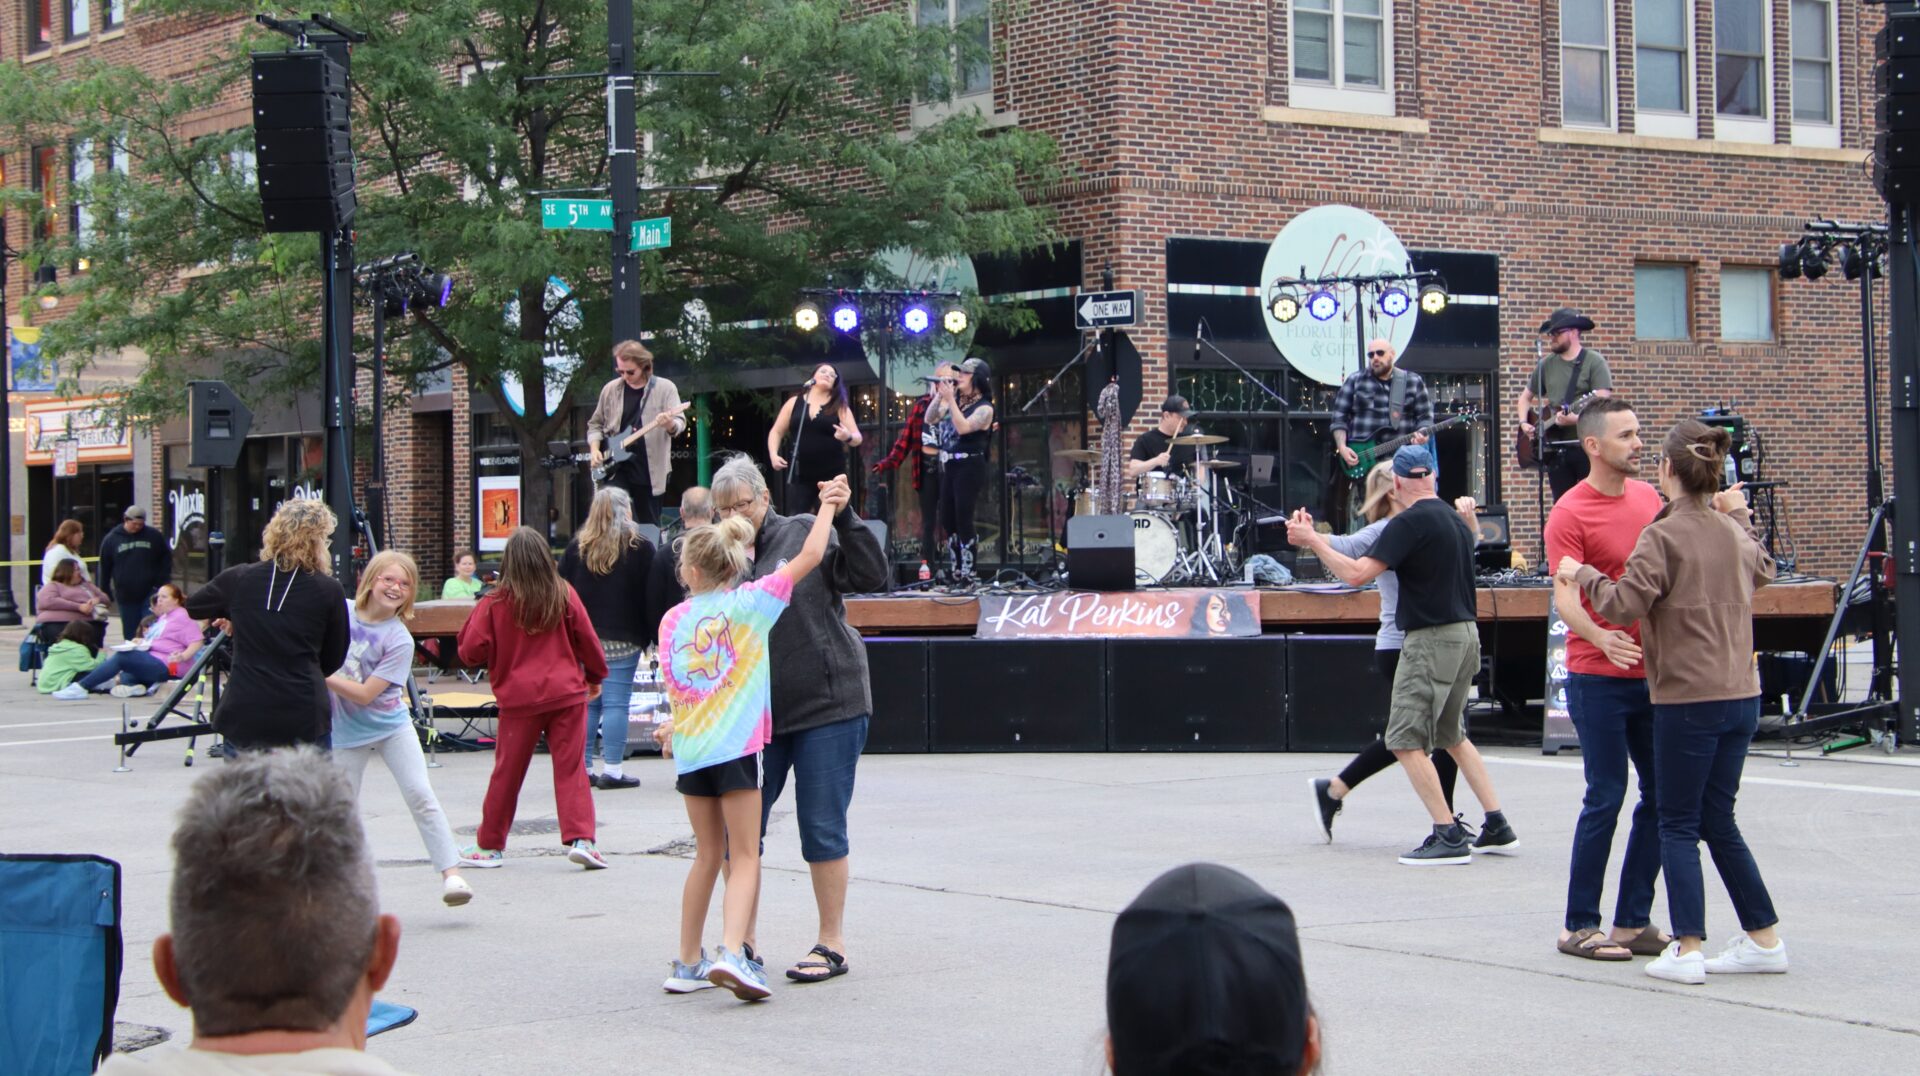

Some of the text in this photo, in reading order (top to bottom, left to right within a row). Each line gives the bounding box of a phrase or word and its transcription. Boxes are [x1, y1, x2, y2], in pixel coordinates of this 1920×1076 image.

[545, 203, 556, 215] SE
[568, 204, 589, 225] 5TH
[632, 222, 670, 246] S Main ST
[1093, 302, 1129, 317] ONE WAY
[1326, 341, 1357, 357] GIFT
[985, 592, 1185, 633] Kat Perkins
